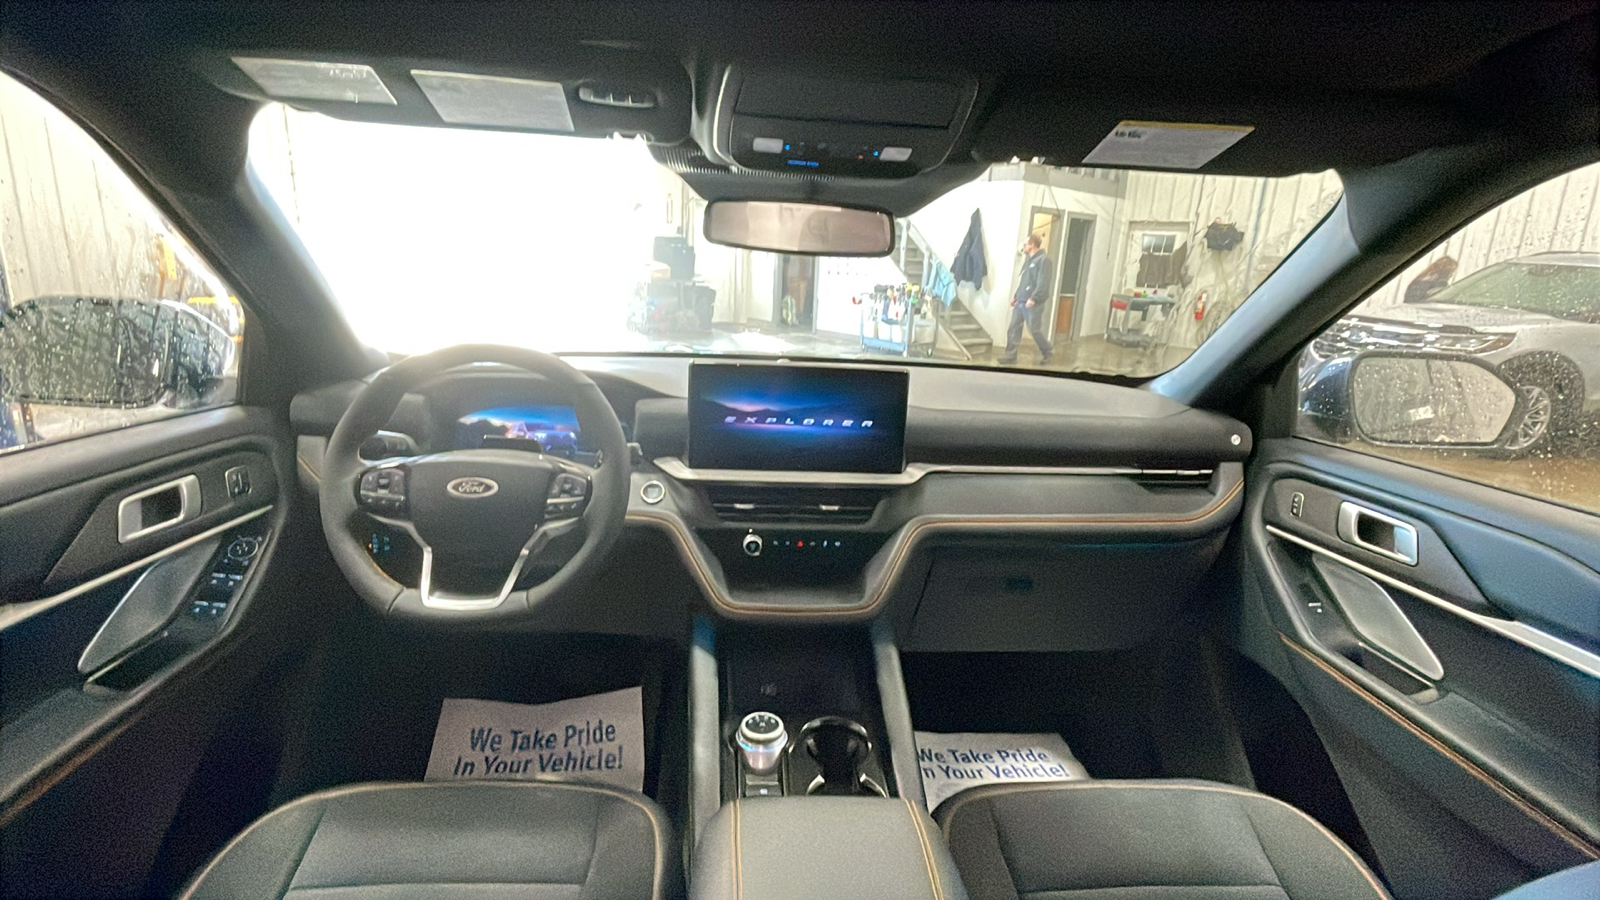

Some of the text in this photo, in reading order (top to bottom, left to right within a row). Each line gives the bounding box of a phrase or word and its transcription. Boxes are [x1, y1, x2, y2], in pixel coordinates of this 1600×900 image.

[724, 416, 874, 428] EXPLORER
[470, 719, 616, 753] We Take Pride
[453, 745, 624, 775] In Your Vehicle!
[919, 747, 1049, 764] We Take Pride
[922, 763, 1070, 779] n Your Vehicle!
